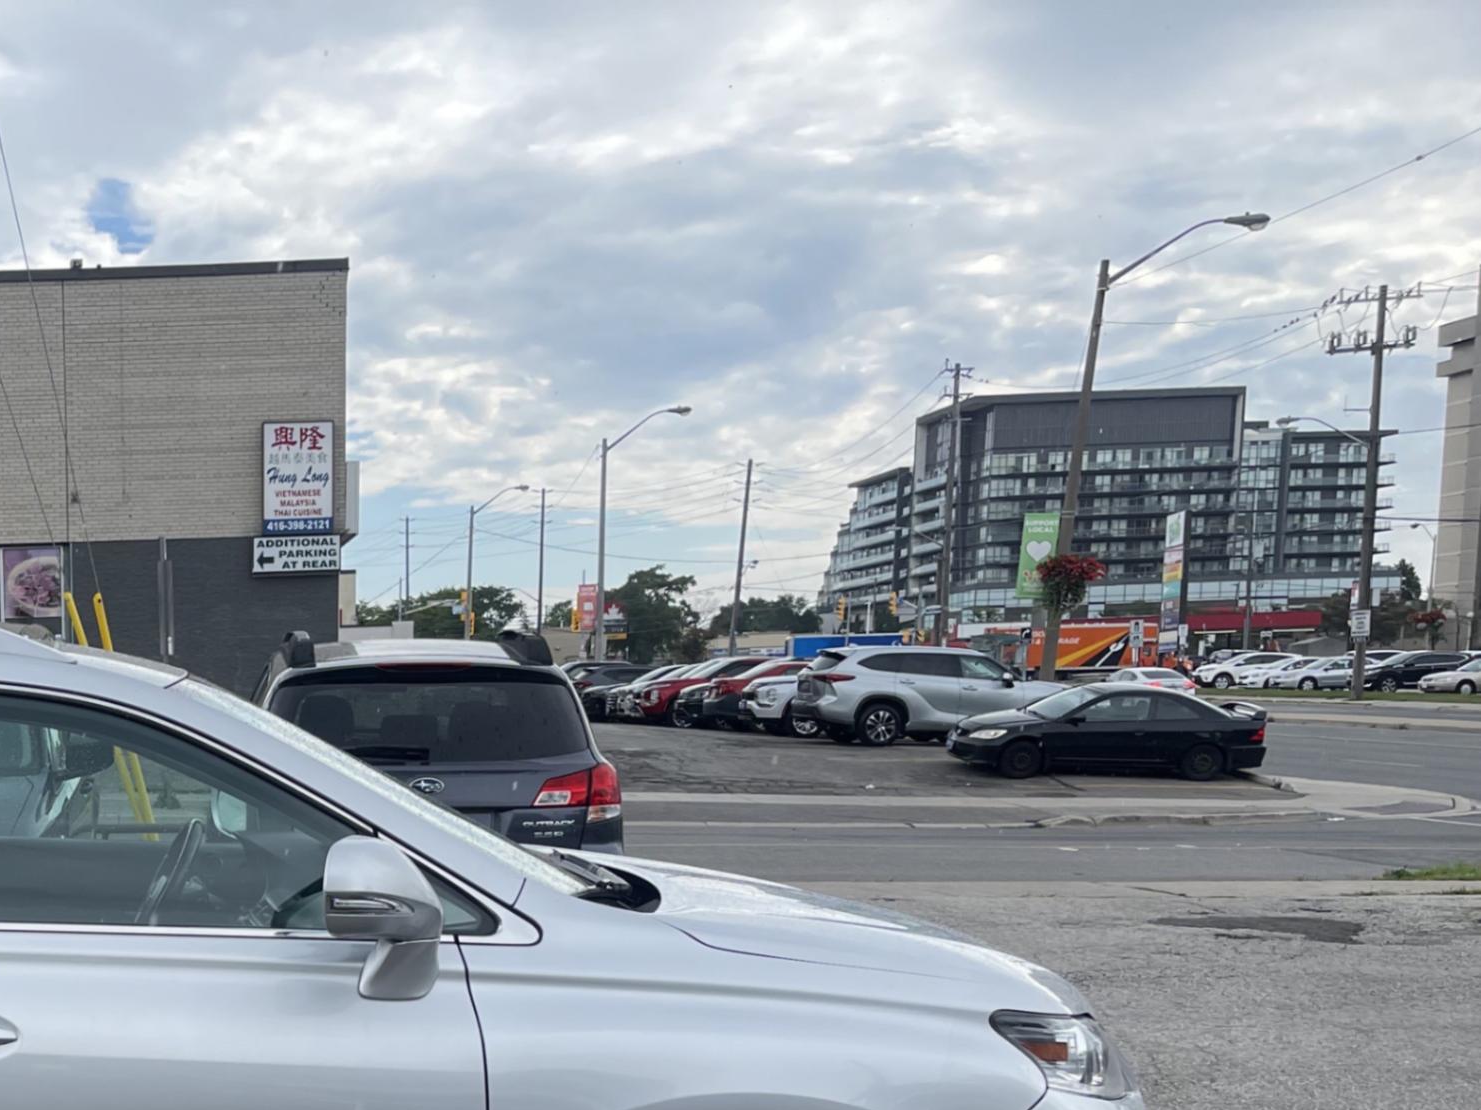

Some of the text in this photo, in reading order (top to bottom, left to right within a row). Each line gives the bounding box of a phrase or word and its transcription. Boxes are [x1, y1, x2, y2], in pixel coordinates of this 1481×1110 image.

[271, 426, 326, 451] 興隆
[266, 465, 330, 488] Hung Long
[275, 489, 322, 498] VIETNAMESE
[280, 499, 317, 507] MALAYSIA
[273, 508, 323, 517] THAI CUISINE
[256, 537, 337, 548] ADDITIONAL
[278, 548, 337, 559] PARKING
[282, 559, 337, 570] AT REAR
